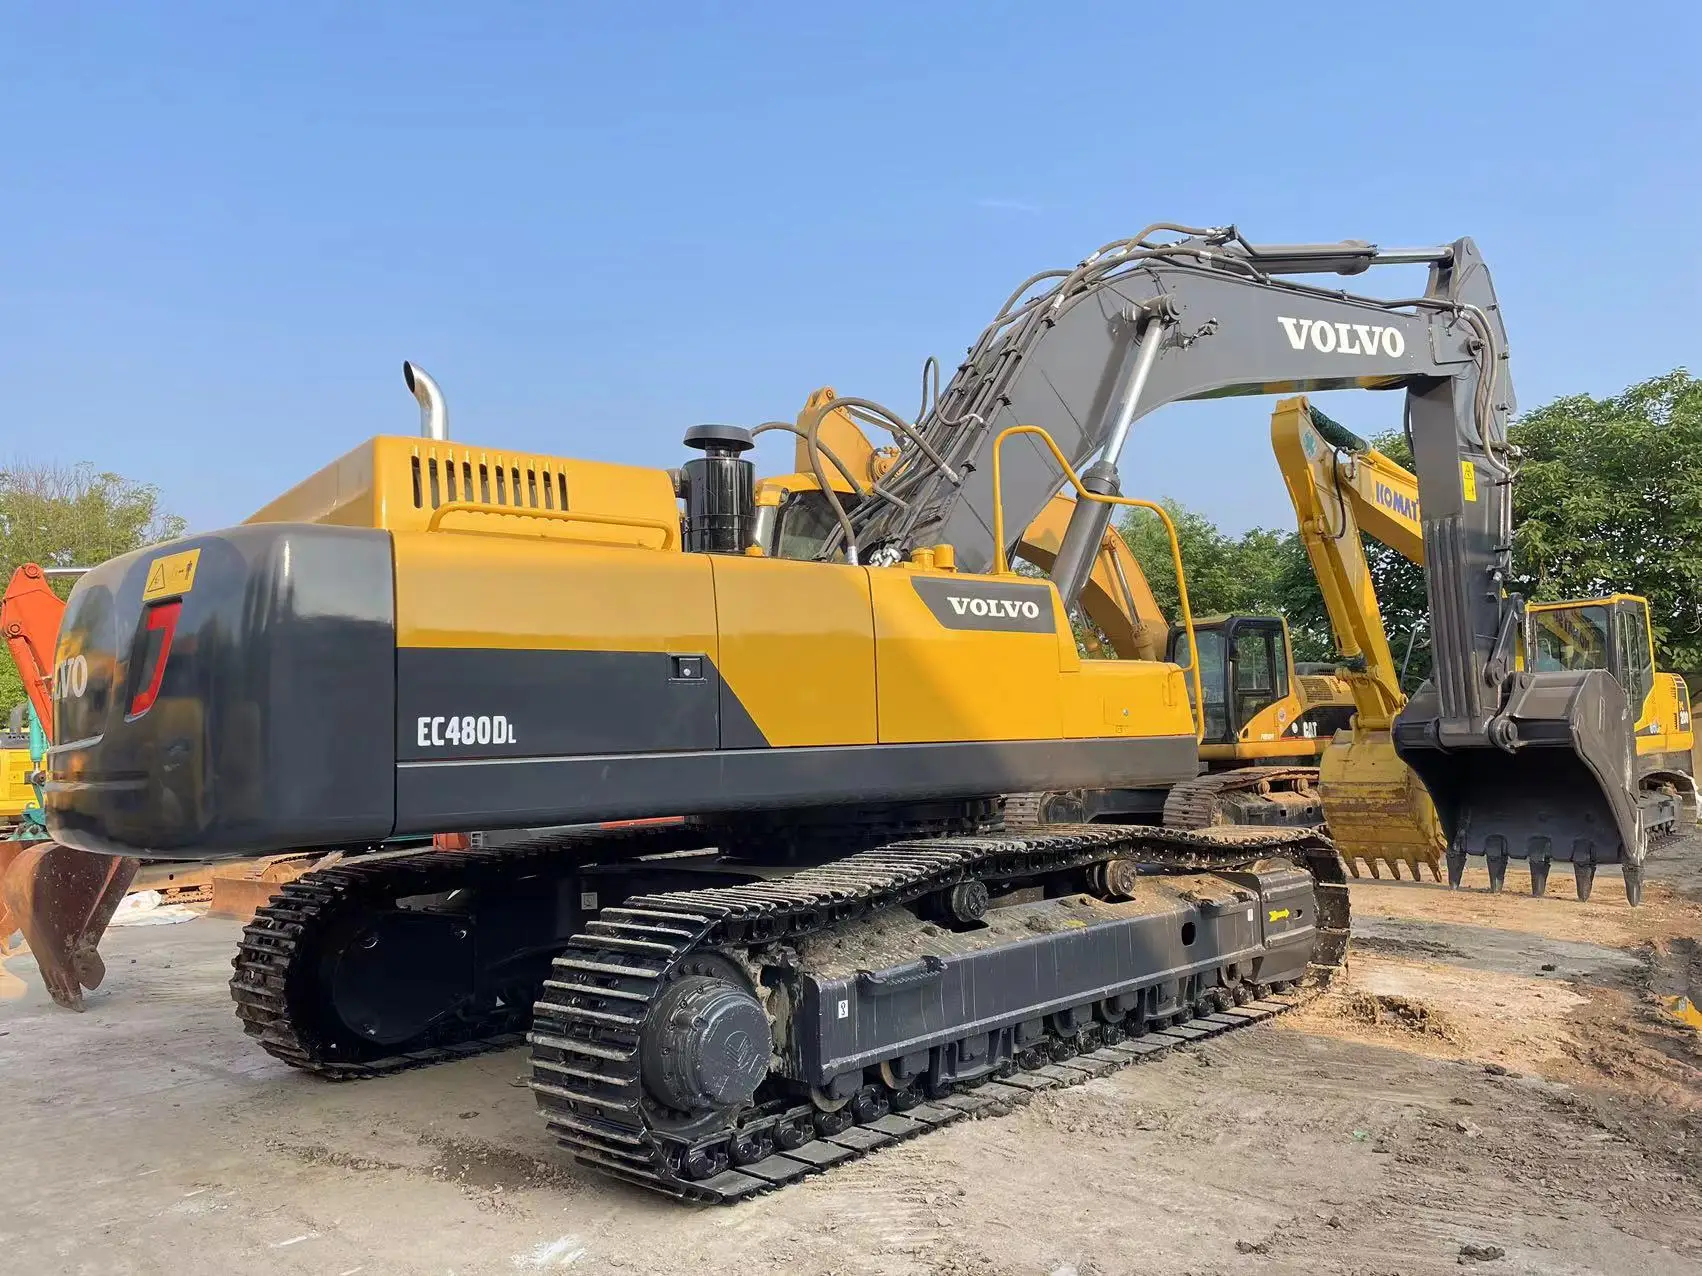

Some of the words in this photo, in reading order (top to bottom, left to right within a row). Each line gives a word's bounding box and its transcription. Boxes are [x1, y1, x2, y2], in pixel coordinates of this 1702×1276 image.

[1277, 316, 1405, 358] VOLVO
[946, 597, 1040, 619] VOLVO
[417, 715, 517, 747] EC480DL
[1302, 721, 1318, 738] CAT
